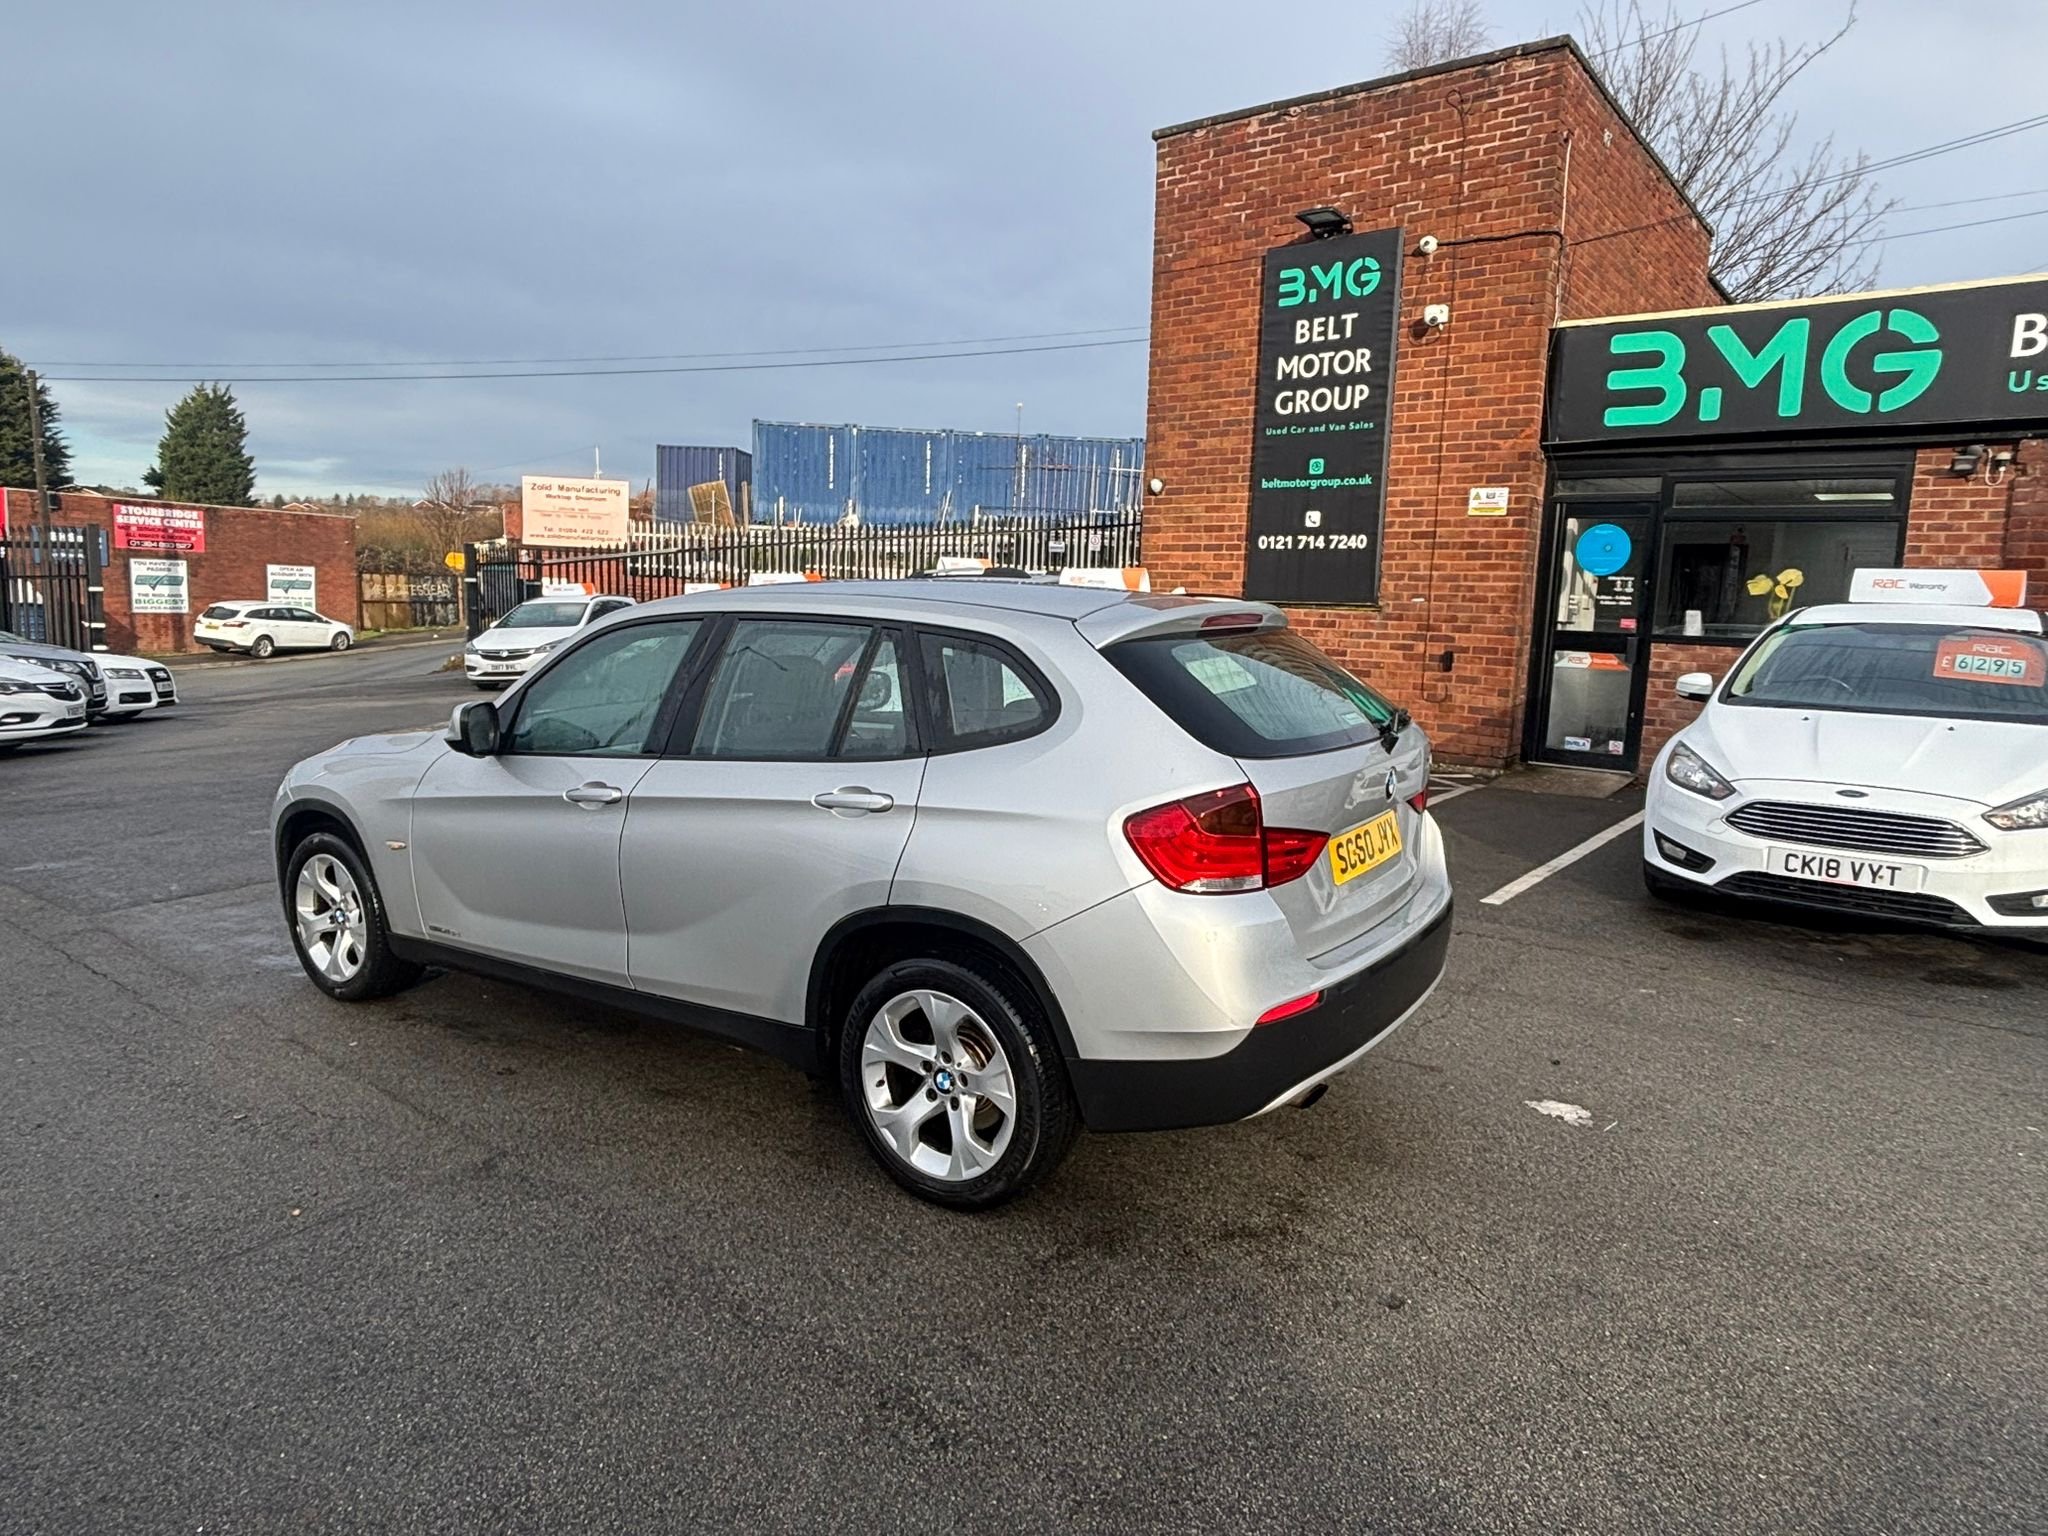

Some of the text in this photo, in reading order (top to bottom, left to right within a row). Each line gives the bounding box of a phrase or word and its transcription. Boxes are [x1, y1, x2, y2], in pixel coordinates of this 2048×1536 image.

[1278, 257, 1381, 307] BMG
[1295, 312, 1359, 344] BELT
[1277, 348, 1371, 380] MOTOR
[1604, 308, 1943, 427] BMG
[1274, 384, 1370, 415] GROUP
[1265, 421, 1374, 435] Used Car and Van Sales
[530, 483, 621, 496] Zolid Manufacturing
[1261, 474, 1373, 490] beltmotorgroup.co.uk
[116, 515, 204, 529] SERVICE CENTRE
[120, 505, 199, 520] STOURBRIDGE
[1258, 534, 1368, 549] 0121 714 7240
[1908, 582, 1949, 592] Warranty
[1376, 816, 1398, 855] JYX
[1784, 853, 1902, 886] CK18 VYT
